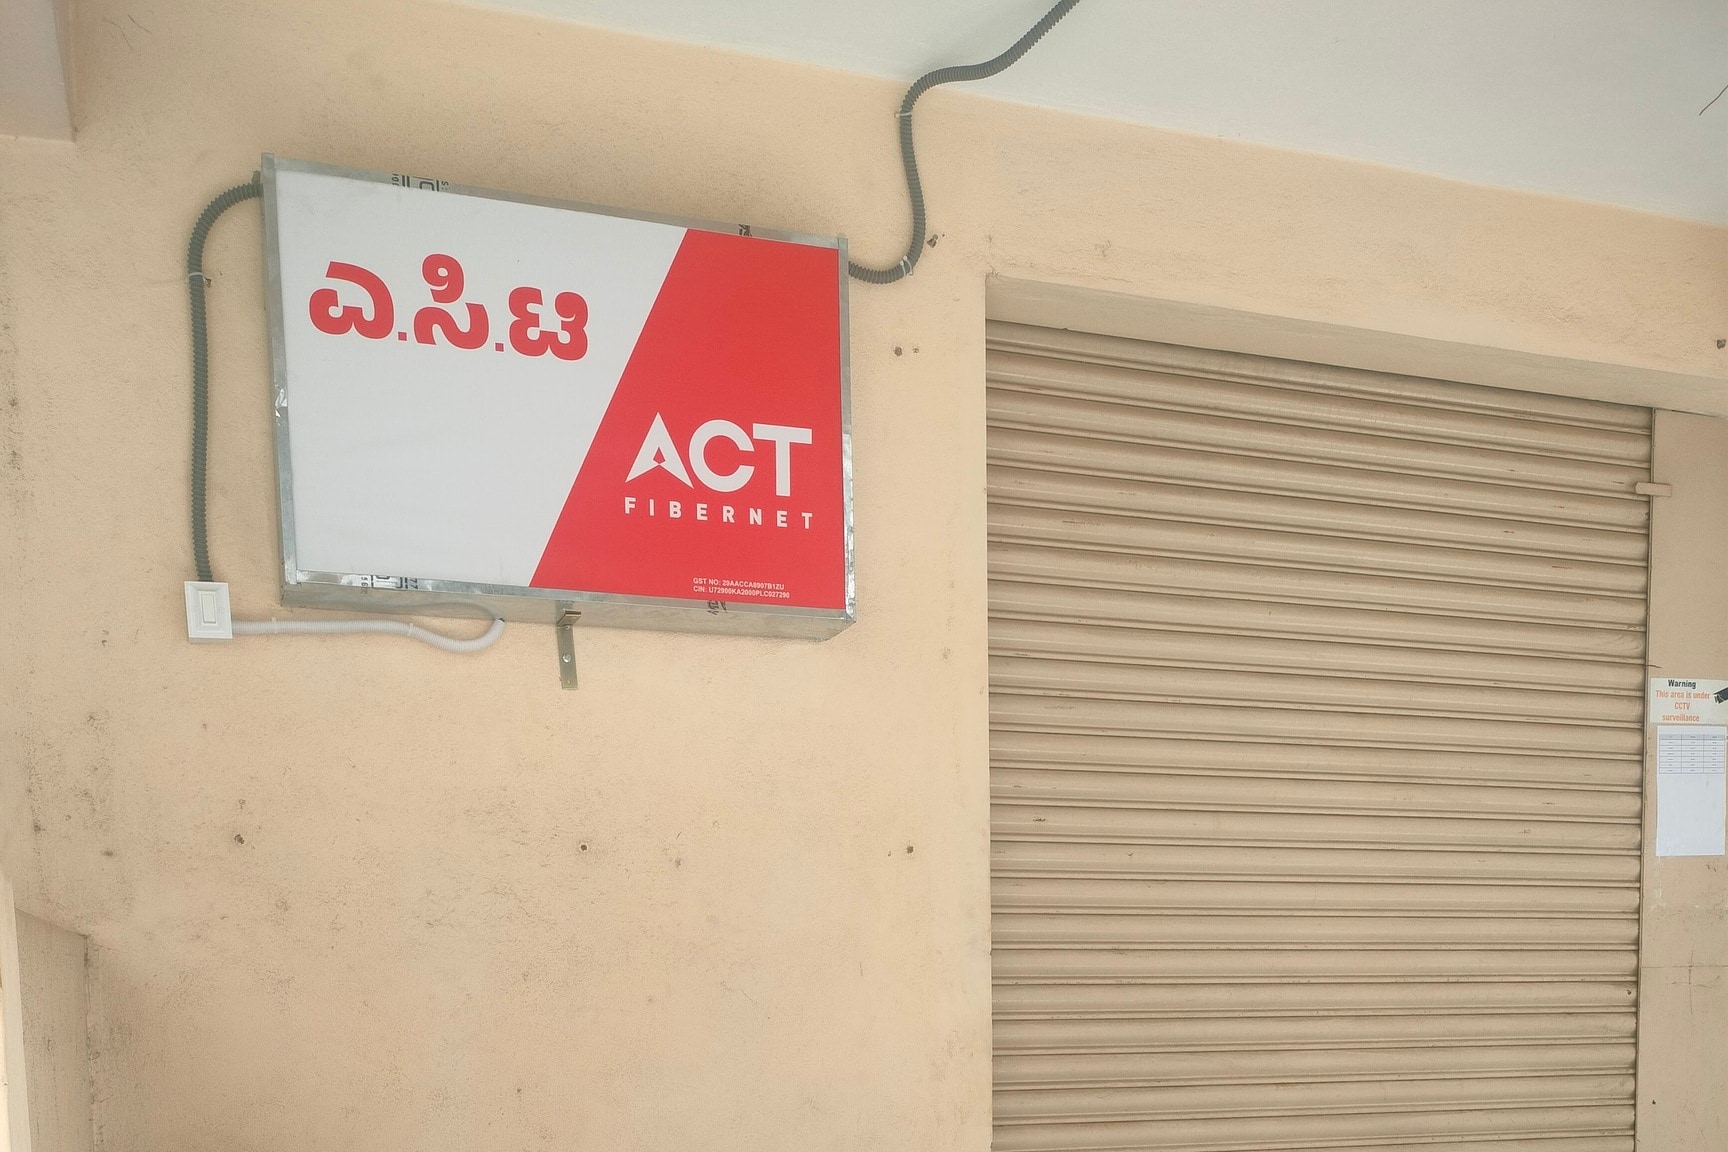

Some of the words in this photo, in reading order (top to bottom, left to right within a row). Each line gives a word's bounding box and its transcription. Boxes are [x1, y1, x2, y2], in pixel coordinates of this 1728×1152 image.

[309, 253, 589, 361] ಎ.ಸಿ.ಟಿ
[625, 412, 812, 497] ACT
[624, 496, 813, 529] FIBERNET
[693, 577, 707, 585] GST
[708, 578, 720, 586] NO:
[693, 585, 707, 593] CIN:
[1668, 680, 1696, 689] Warning
[1656, 690, 1669, 698] This
[1693, 691, 1710, 699] under
[1675, 702, 1690, 710] CCTV
[1662, 713, 1700, 722] surveillance
